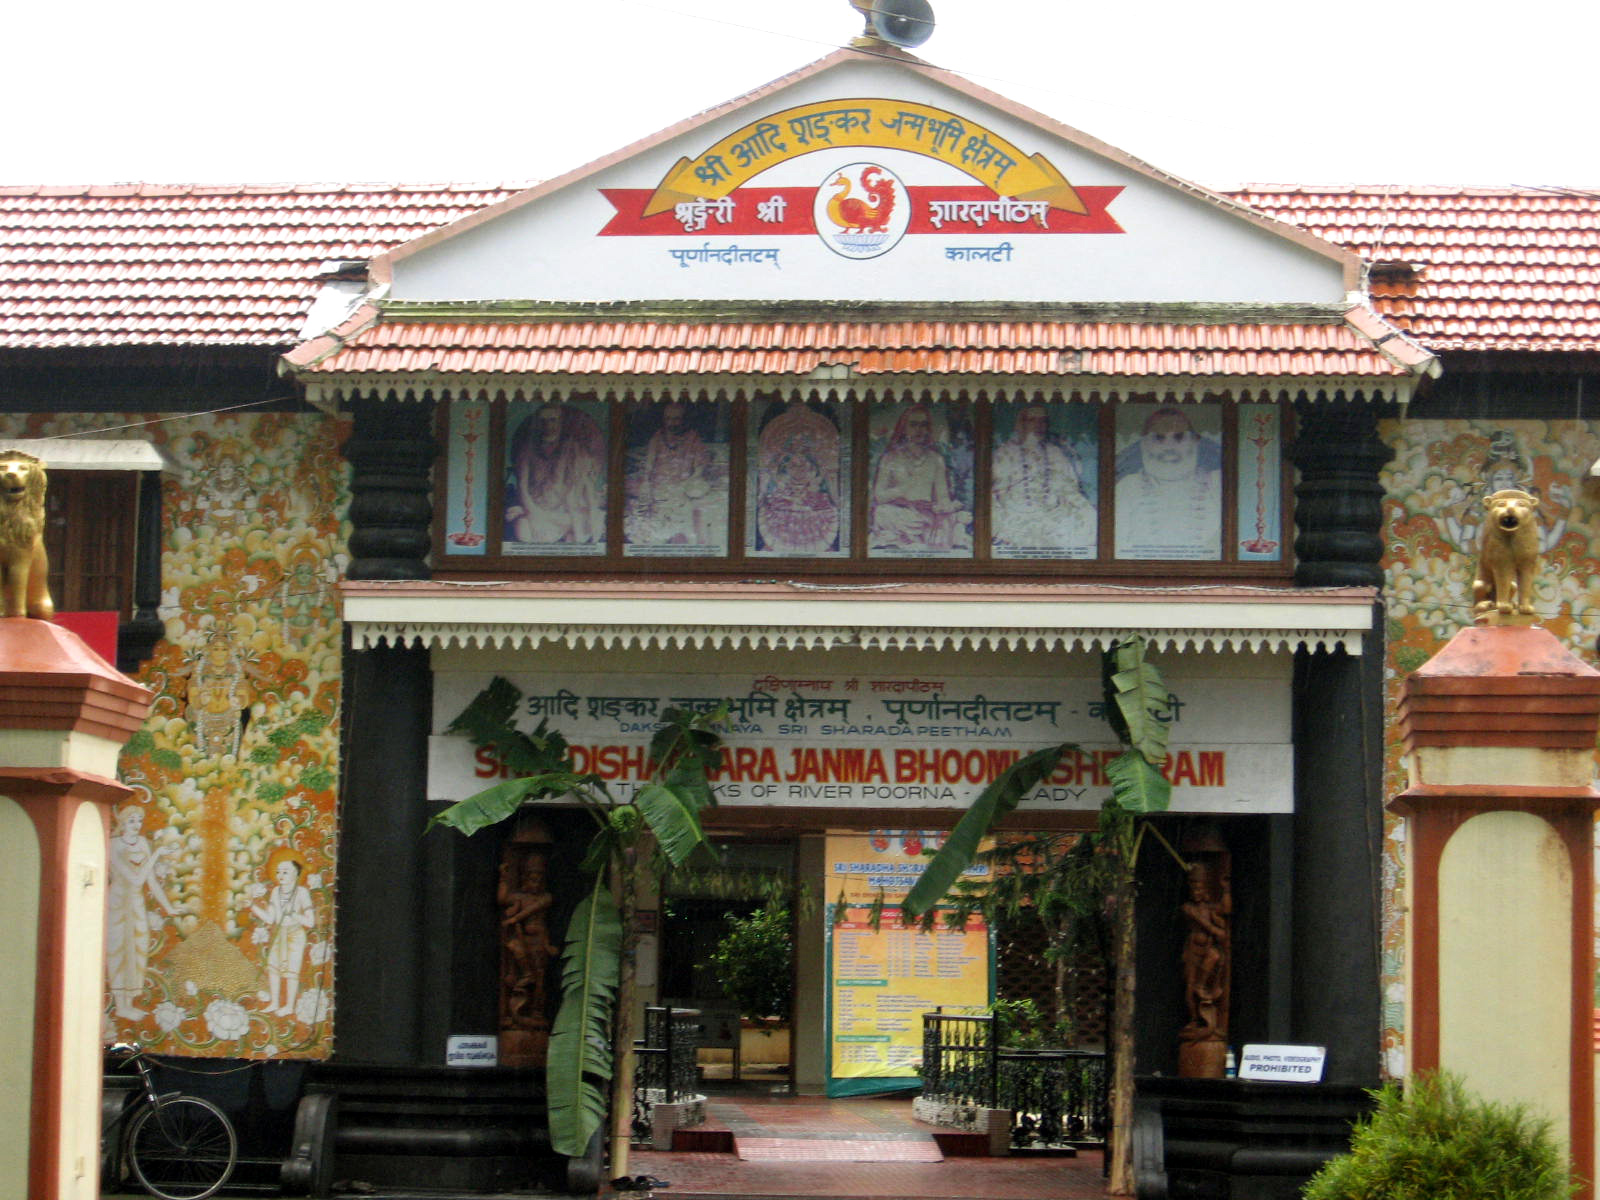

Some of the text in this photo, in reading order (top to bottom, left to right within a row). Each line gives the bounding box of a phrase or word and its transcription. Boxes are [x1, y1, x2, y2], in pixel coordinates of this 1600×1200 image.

[756, 194, 788, 224] श्री
[528, 689, 580, 720] आदि
[778, 724, 808, 735] SRI
[786, 748, 889, 784] JANMA
[750, 784, 777, 798] OF
[788, 785, 852, 799] RIVER
[862, 786, 956, 800] POORNA
[1249, 1063, 1312, 1073] PROHIBITED
